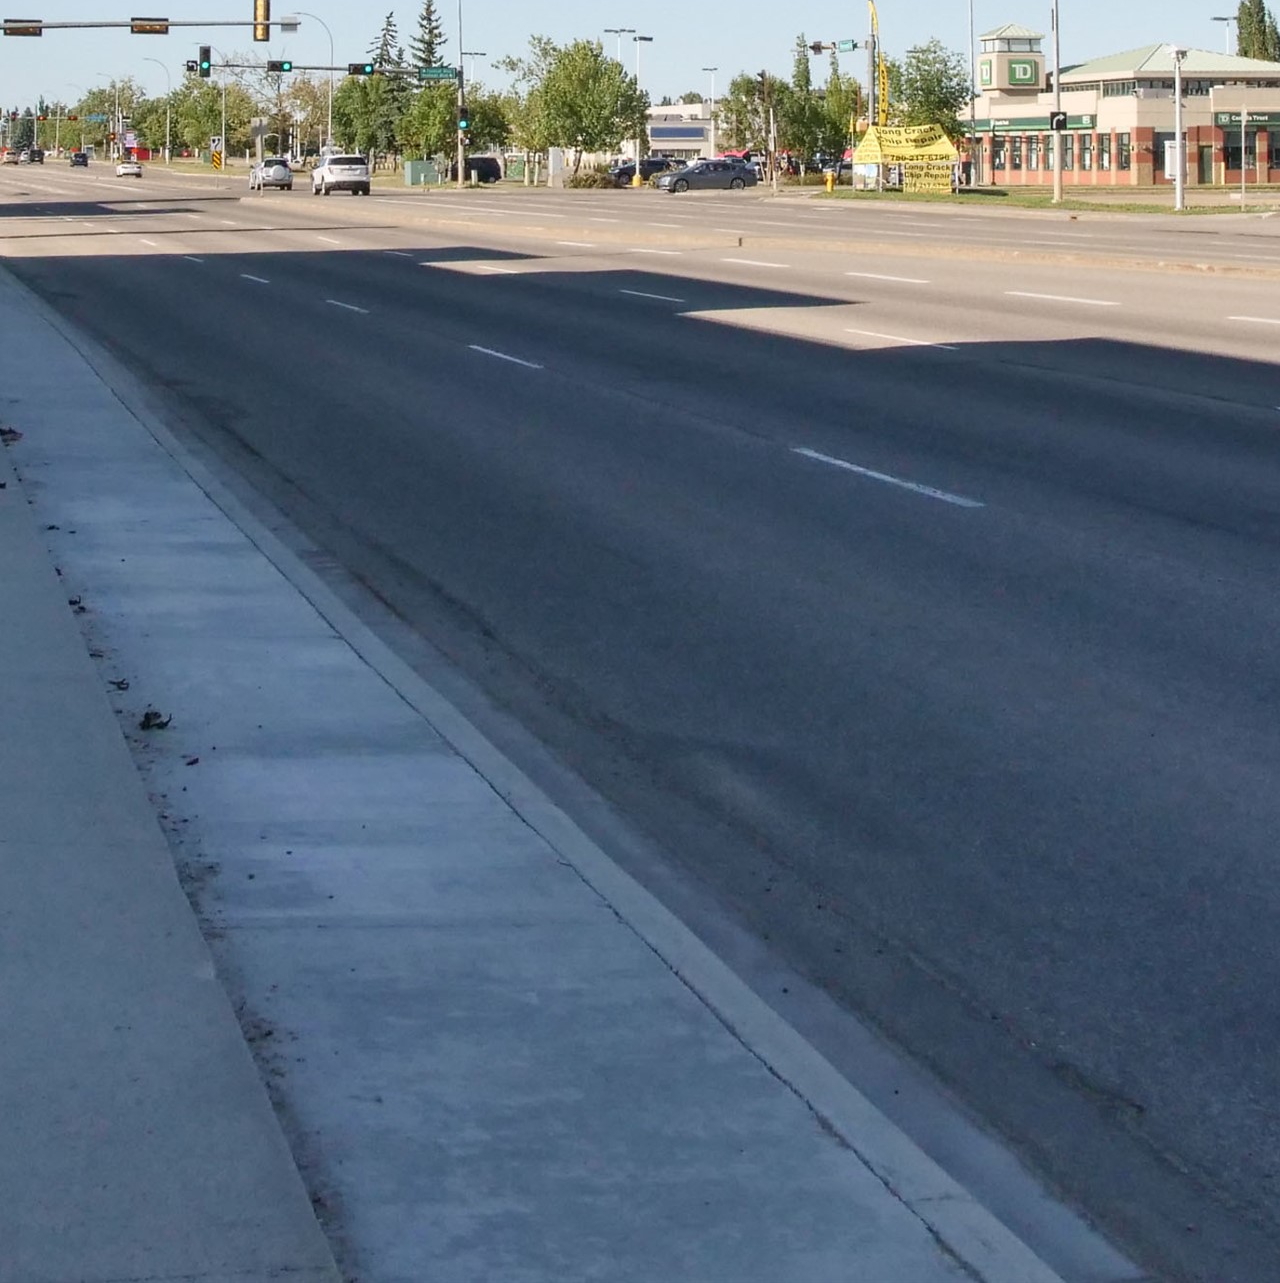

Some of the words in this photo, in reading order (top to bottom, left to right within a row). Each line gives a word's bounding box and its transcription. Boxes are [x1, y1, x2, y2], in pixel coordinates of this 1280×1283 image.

[1011, 64, 1032, 79] TD
[875, 127, 902, 136] Long
[904, 125, 937, 135] Crack
[876, 136, 903, 145] Chip
[905, 133, 944, 145] Repair
[904, 163, 924, 172] Long
[925, 163, 951, 172] Crack
[904, 171, 923, 179] Chip
[924, 172, 951, 180] Repair
